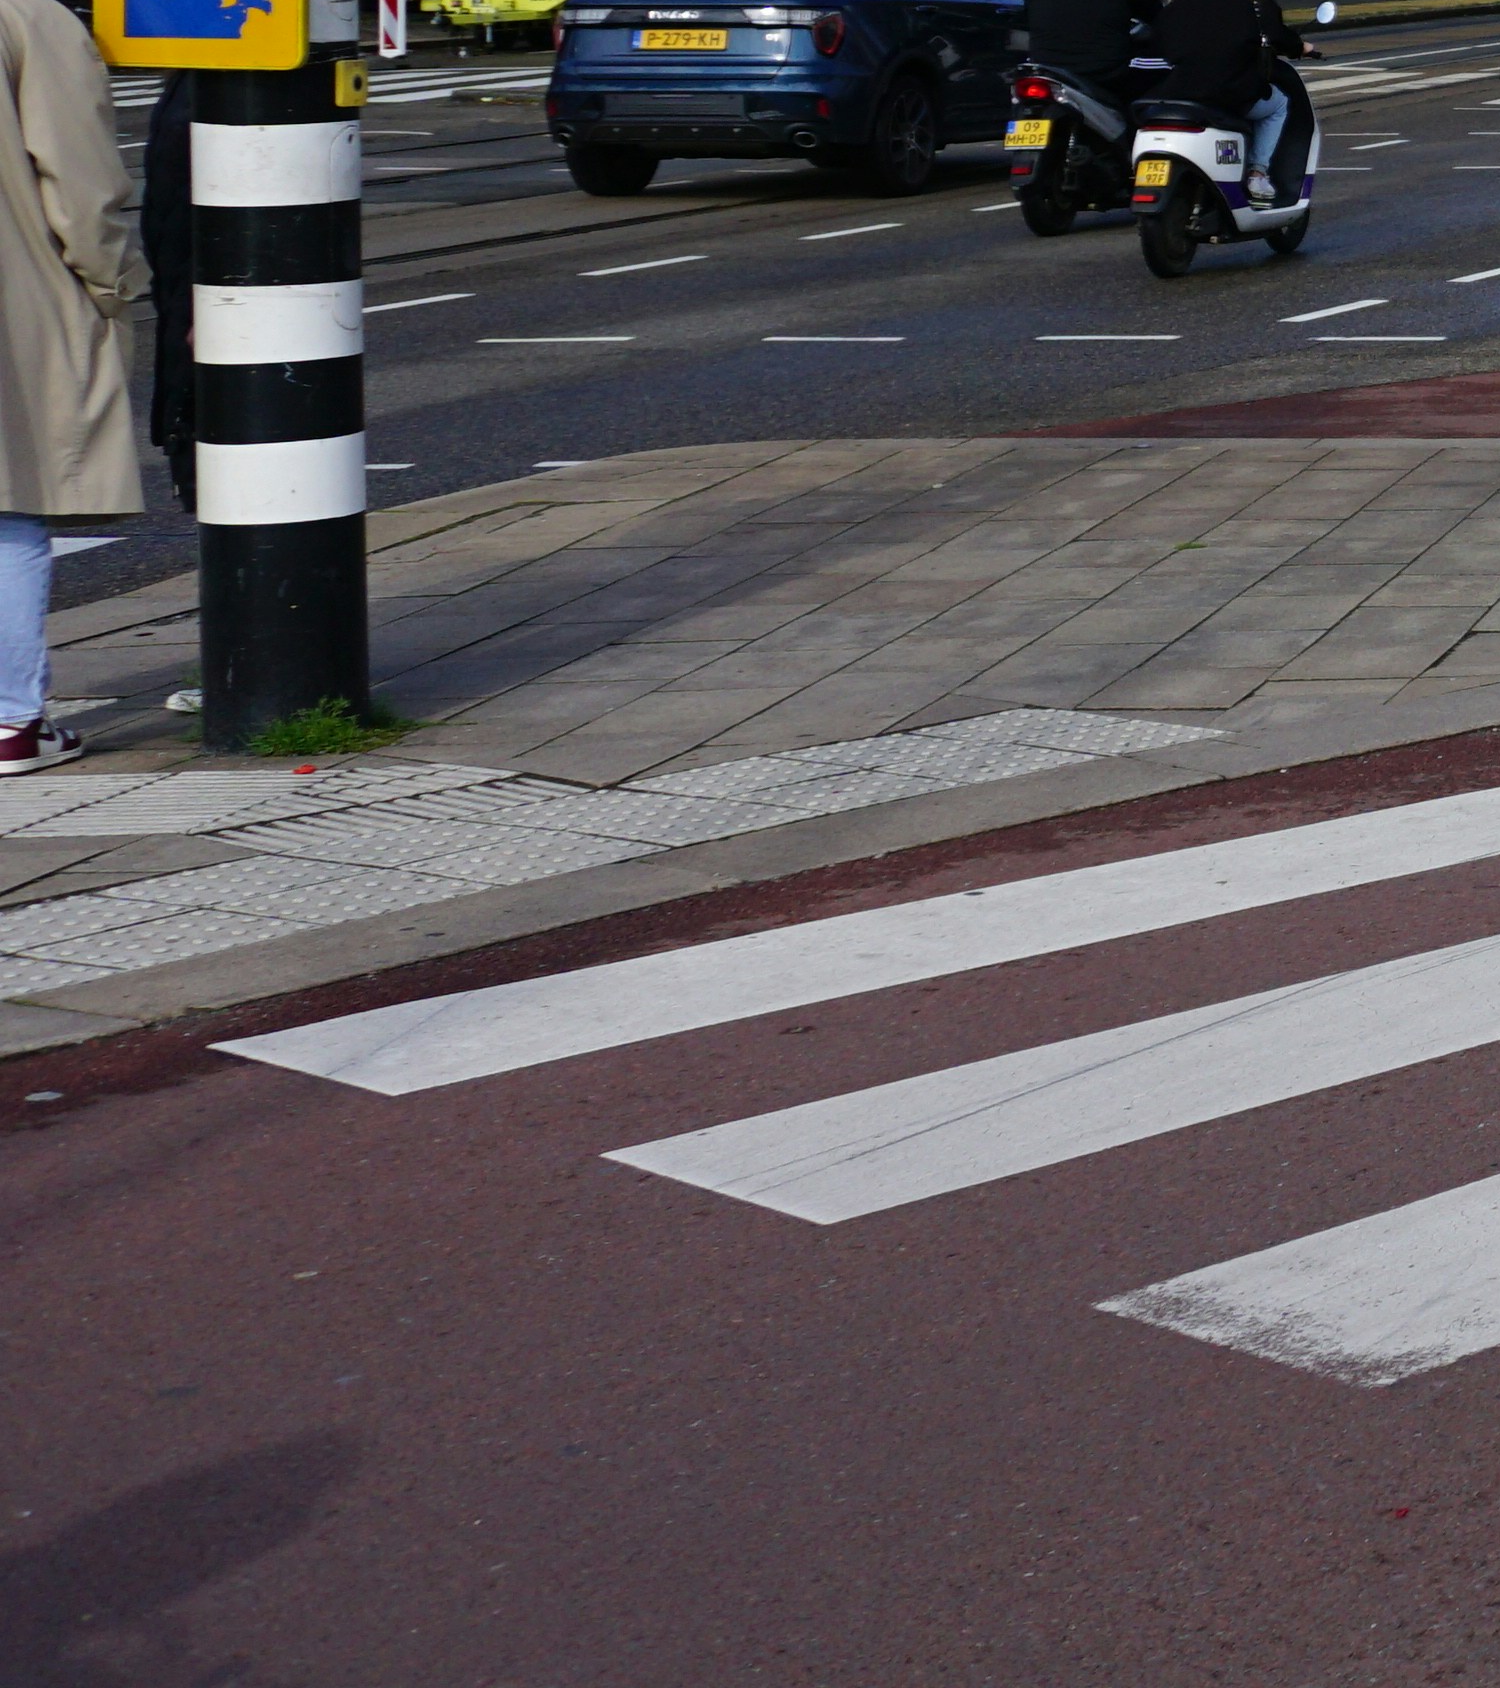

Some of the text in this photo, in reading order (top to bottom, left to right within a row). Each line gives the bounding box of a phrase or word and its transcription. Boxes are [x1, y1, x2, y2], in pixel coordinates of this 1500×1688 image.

[647, 32, 720, 47] P-279-KH
[1023, 121, 1041, 132] 09
[1006, 133, 1046, 145] MH-DF
